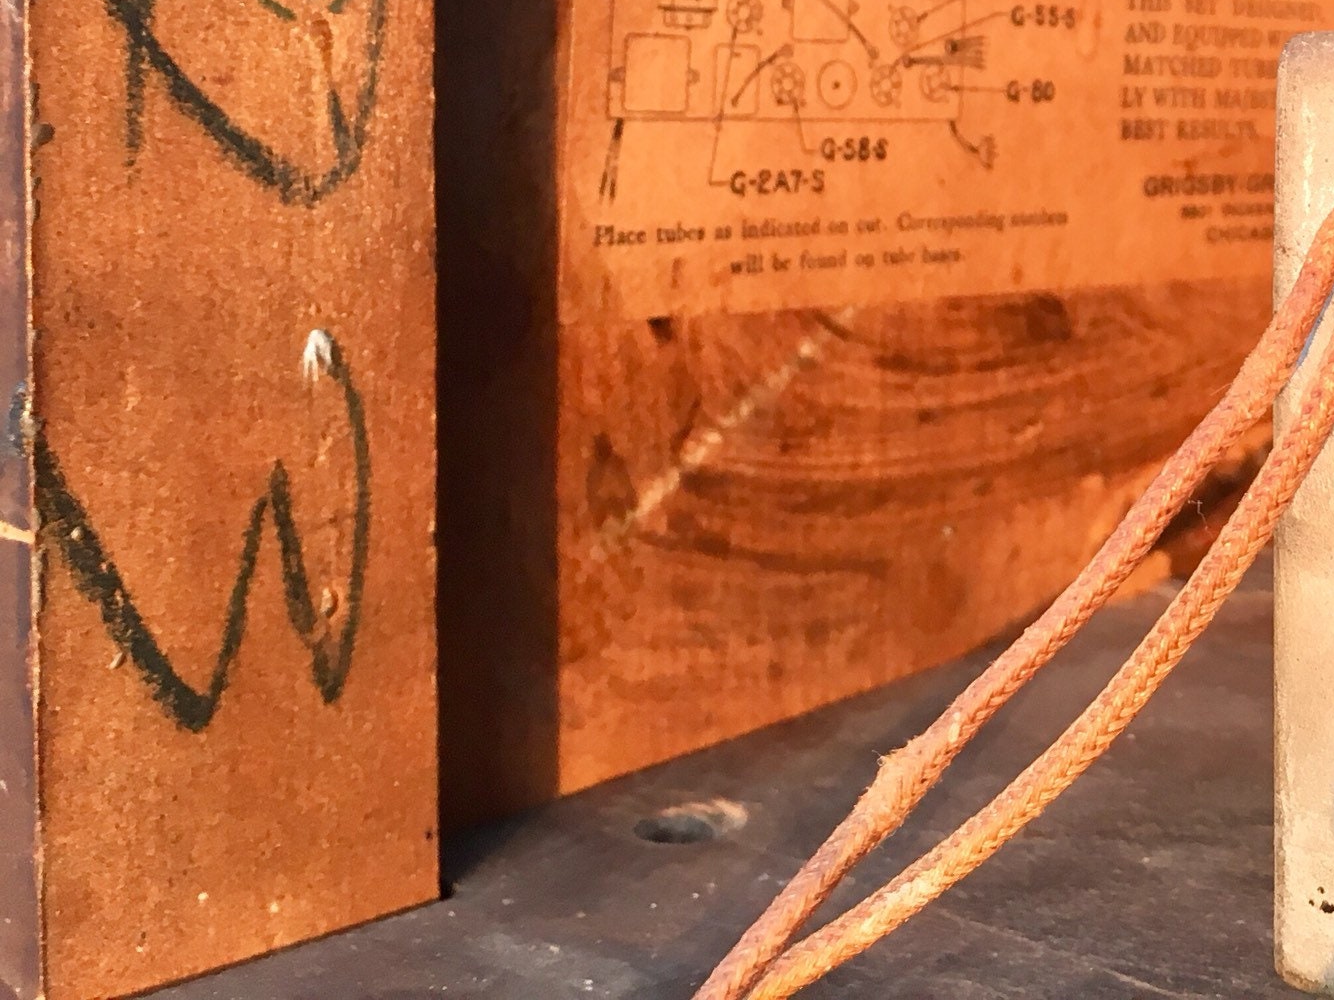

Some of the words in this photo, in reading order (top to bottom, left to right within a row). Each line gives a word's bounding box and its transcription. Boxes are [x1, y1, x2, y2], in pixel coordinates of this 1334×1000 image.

[1006, 78, 1057, 103] G-80
[729, 169, 826, 197] G-2A7-S
[594, 224, 647, 247] Place
[656, 223, 706, 244] tubes
[741, 213, 821, 241] indicated
